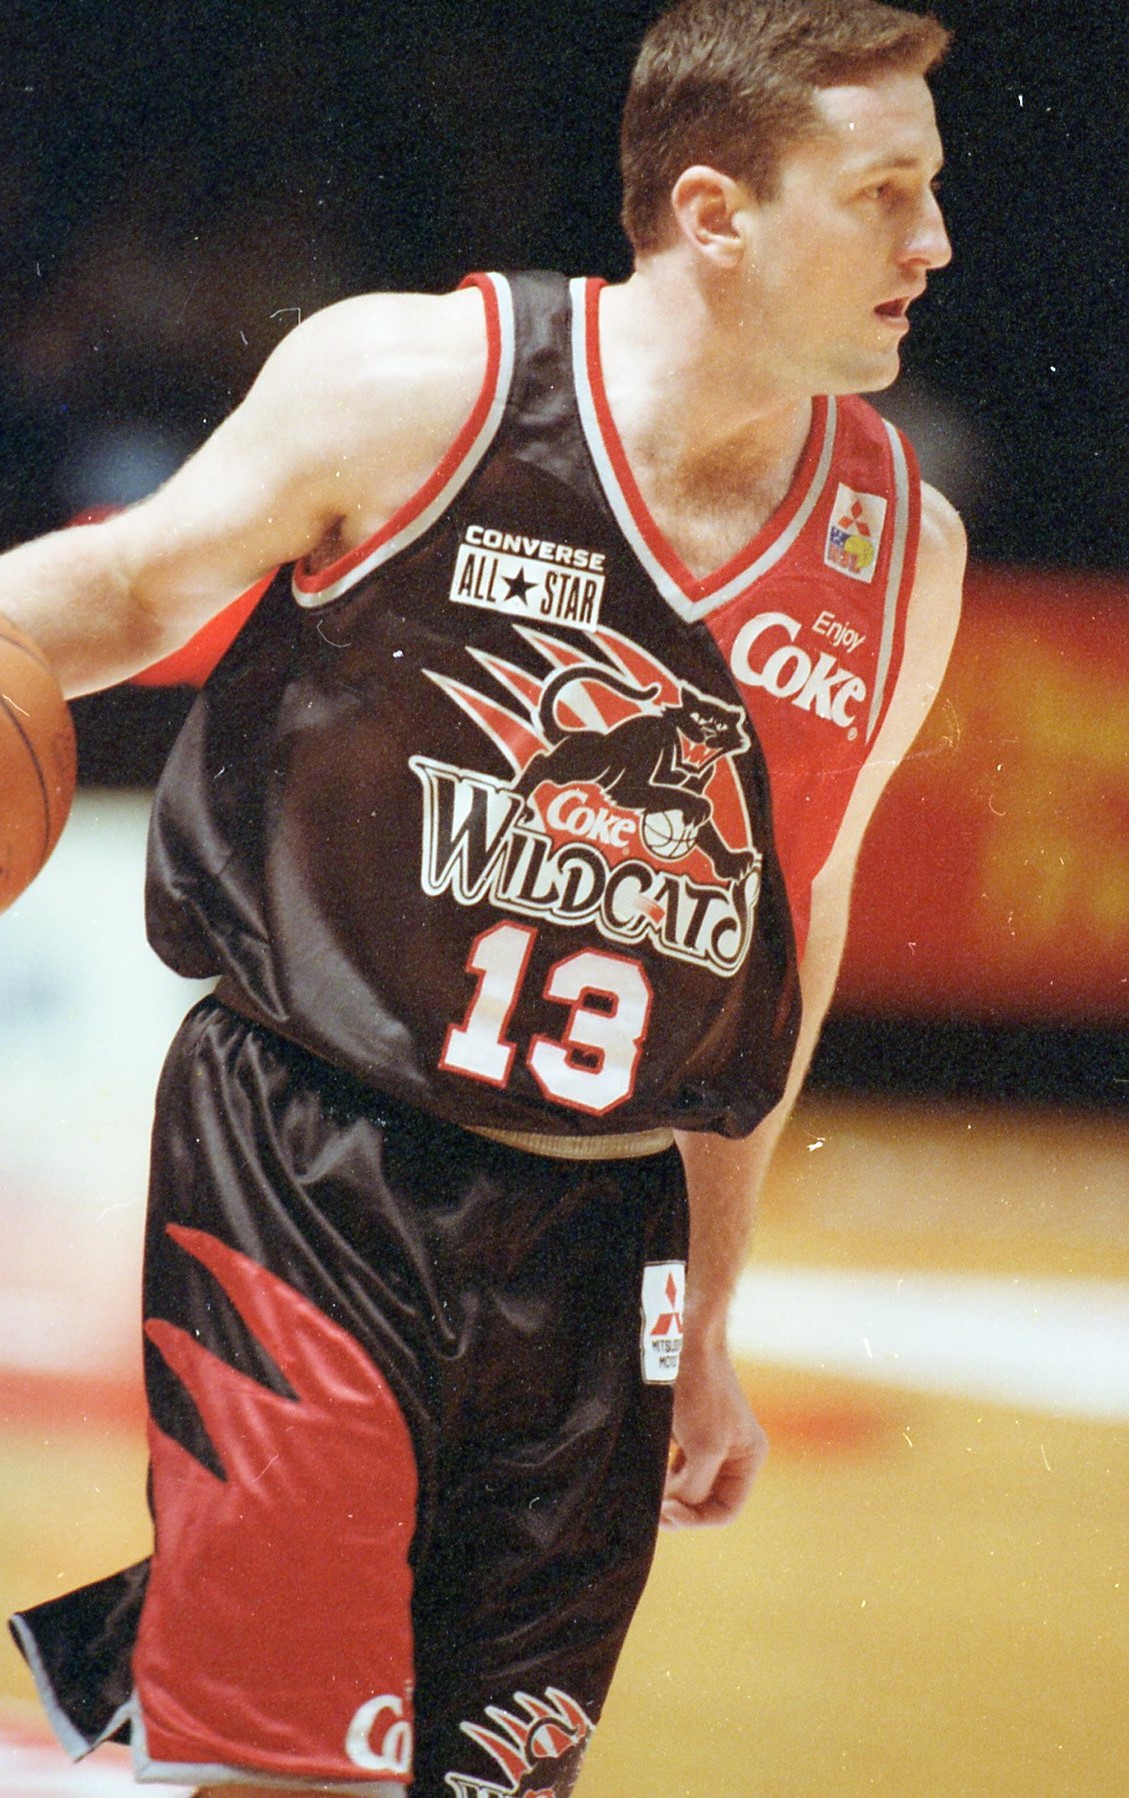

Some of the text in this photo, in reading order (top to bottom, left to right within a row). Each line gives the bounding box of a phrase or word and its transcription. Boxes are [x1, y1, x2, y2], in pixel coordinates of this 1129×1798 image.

[465, 524, 606, 571] CONVERSE
[458, 553, 598, 625] ALL STAR
[811, 610, 866, 653] Enjoy
[730, 611, 867, 728] Coke
[546, 789, 636, 847] Coke
[438, 919, 654, 1117] 13
